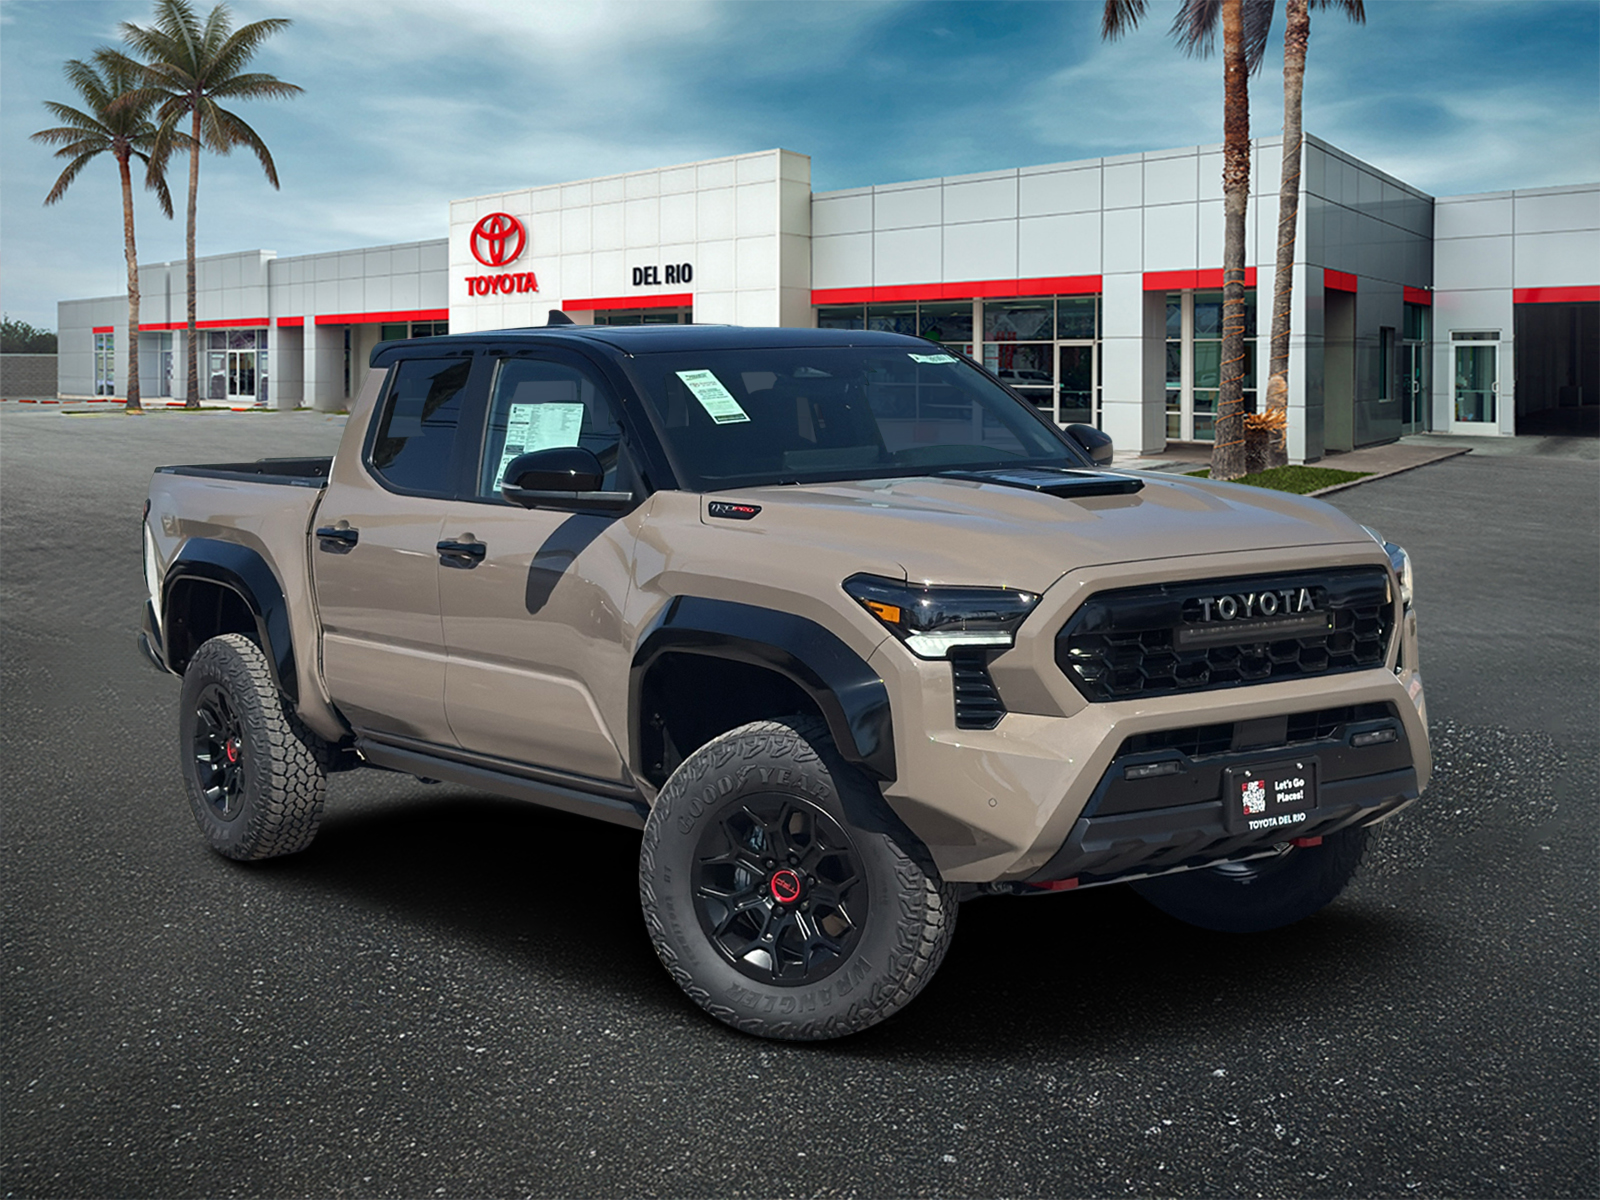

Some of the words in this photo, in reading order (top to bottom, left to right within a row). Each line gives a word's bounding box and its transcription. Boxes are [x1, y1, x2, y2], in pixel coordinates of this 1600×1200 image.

[465, 272, 538, 296] TOYOTA
[632, 266, 661, 286] DEL
[665, 263, 693, 284] RIO
[1198, 588, 1315, 622] TOYOTA
[1274, 779, 1292, 791] Let's
[1293, 778, 1305, 788] Go
[1276, 789, 1304, 803] Places!
[678, 764, 831, 835] GOODYEAR
[1248, 817, 1277, 830] TOYOTA
[1278, 815, 1292, 825] DEL
[1293, 812, 1306, 823] RIO
[724, 955, 874, 1015] WRANGLER
